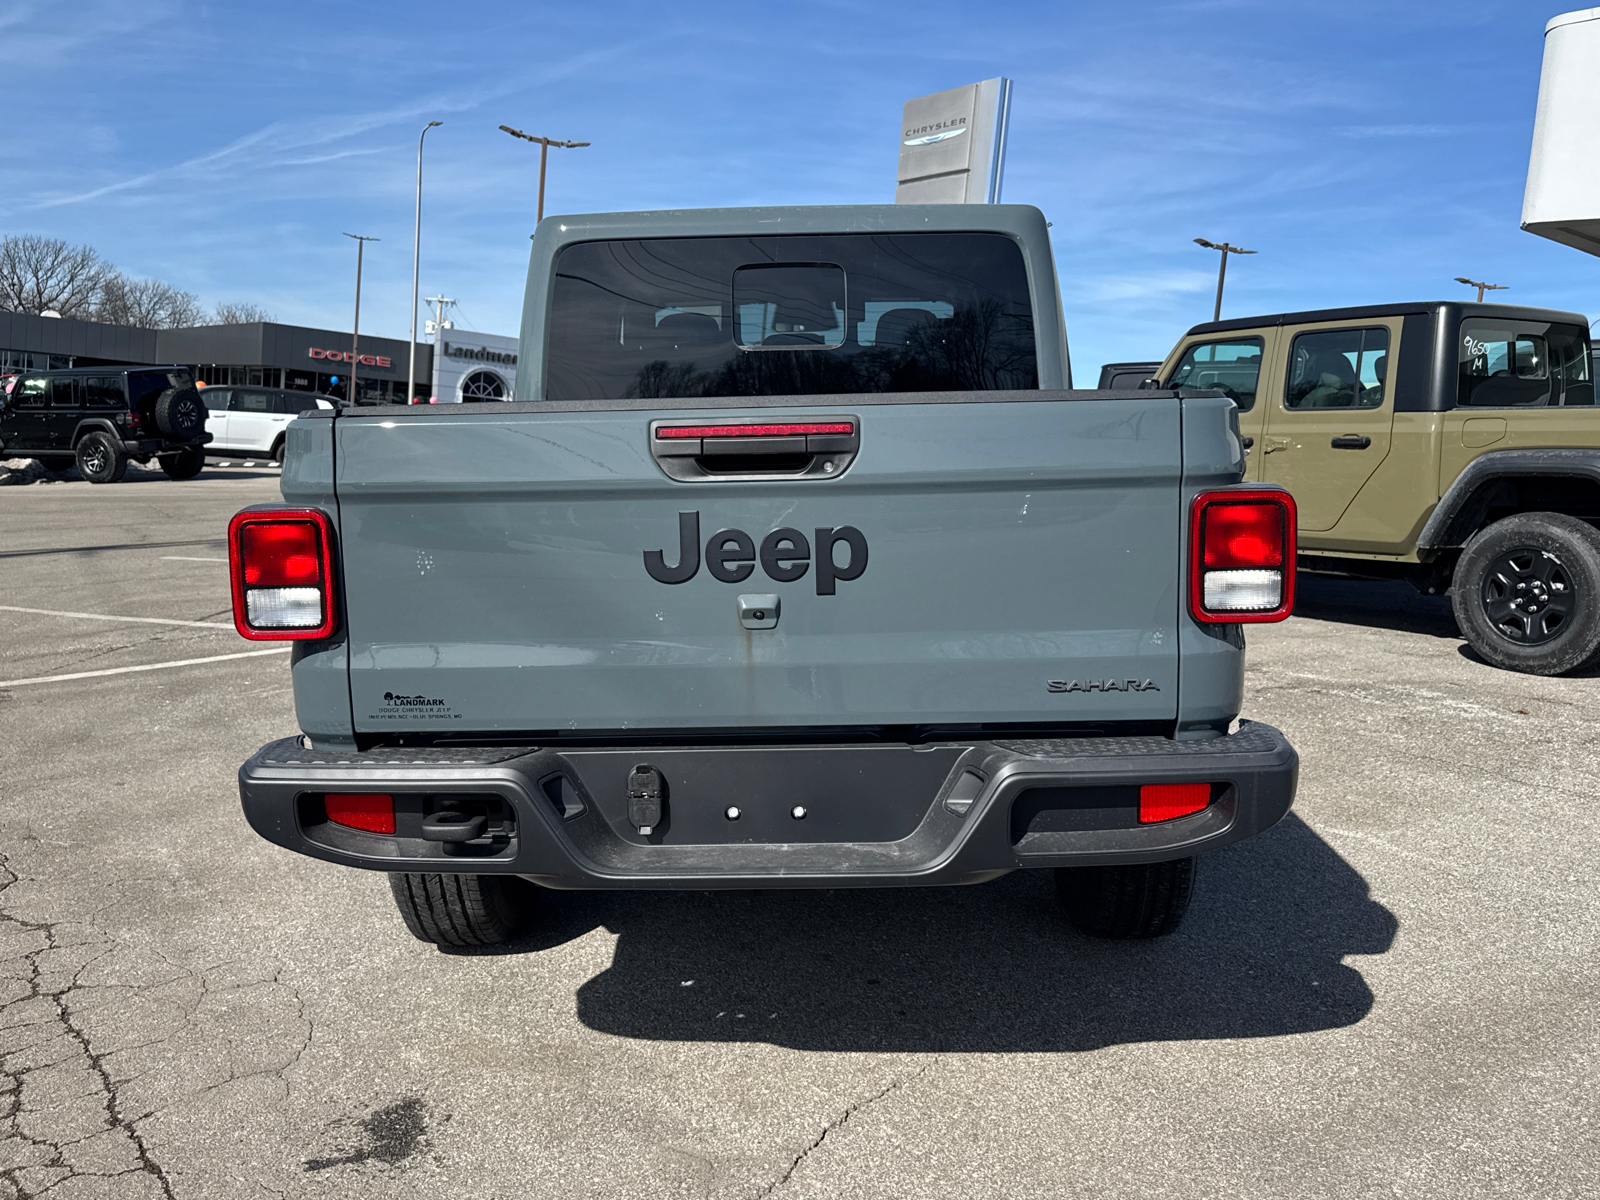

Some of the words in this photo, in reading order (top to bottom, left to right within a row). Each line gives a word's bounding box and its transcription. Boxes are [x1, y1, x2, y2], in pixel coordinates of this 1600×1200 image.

[905, 117, 967, 137] CHRYSLER
[308, 347, 392, 368] DODGE
[443, 341, 518, 365] Landmar
[1472, 357, 1483, 370] M
[643, 510, 869, 596] Jeep
[1046, 678, 1161, 694] SAHARA
